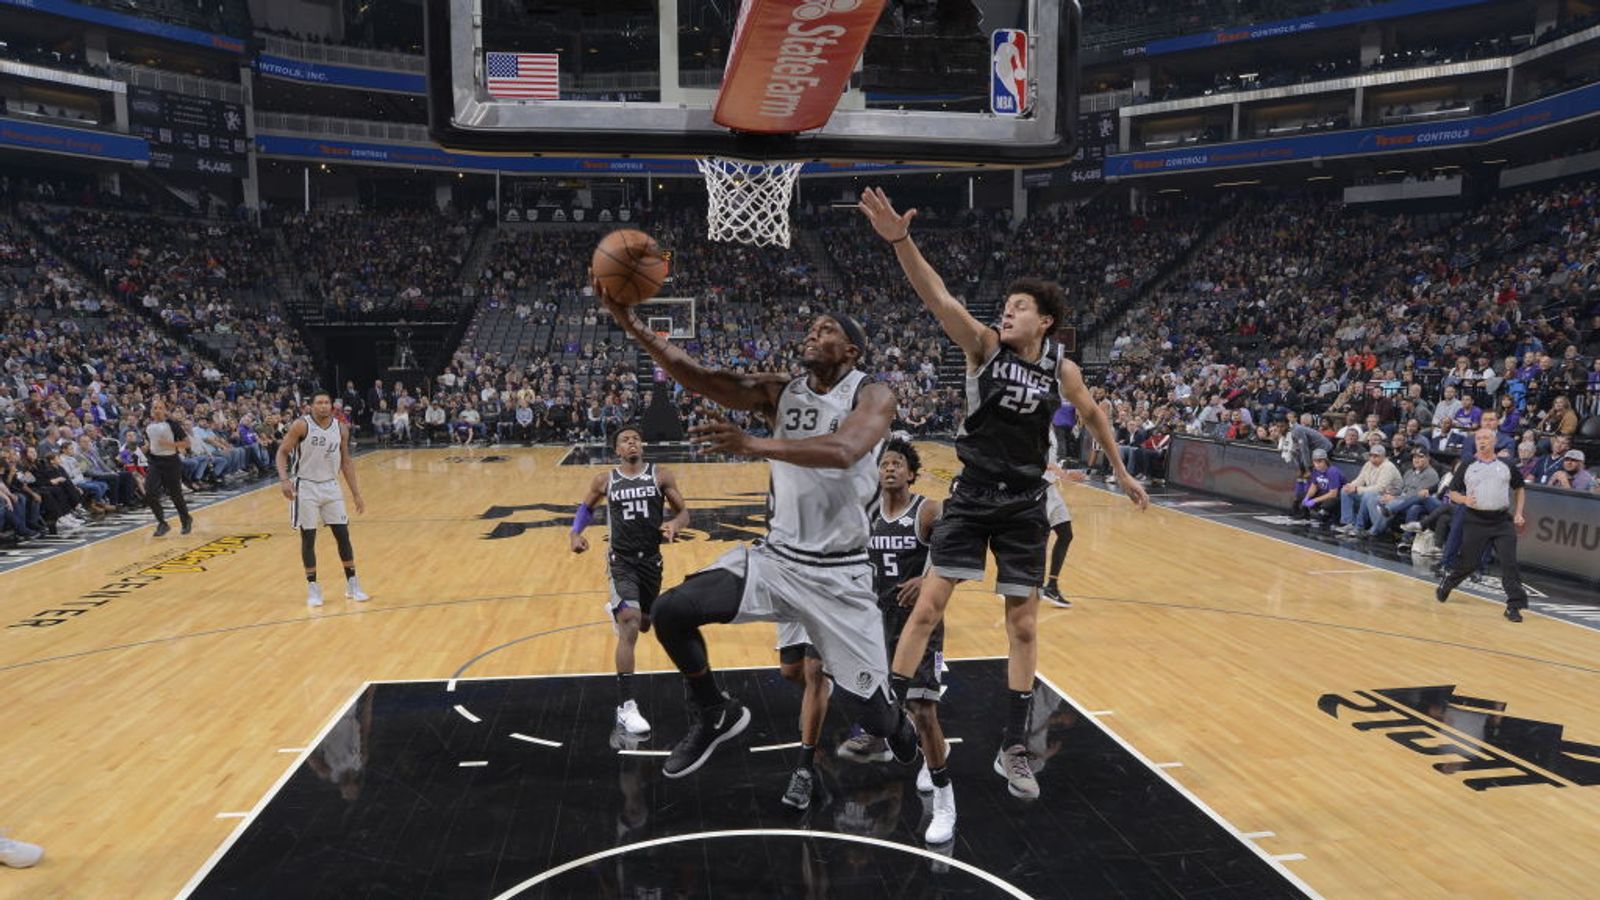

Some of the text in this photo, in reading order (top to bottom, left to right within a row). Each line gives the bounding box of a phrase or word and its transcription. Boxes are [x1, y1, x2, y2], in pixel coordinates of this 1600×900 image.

[996, 95, 1014, 109] NBA
[1416, 128, 1470, 143] CONTROLS
[992, 361, 1054, 393] KINGS
[1000, 385, 1041, 414] 25
[785, 408, 819, 431] 33
[311, 436, 327, 447] 22
[611, 486, 656, 501] KINGS
[622, 500, 650, 520] 24
[1536, 516, 1600, 551] SMU
[882, 553, 899, 576] 5
[6, 574, 163, 629] CENTER
